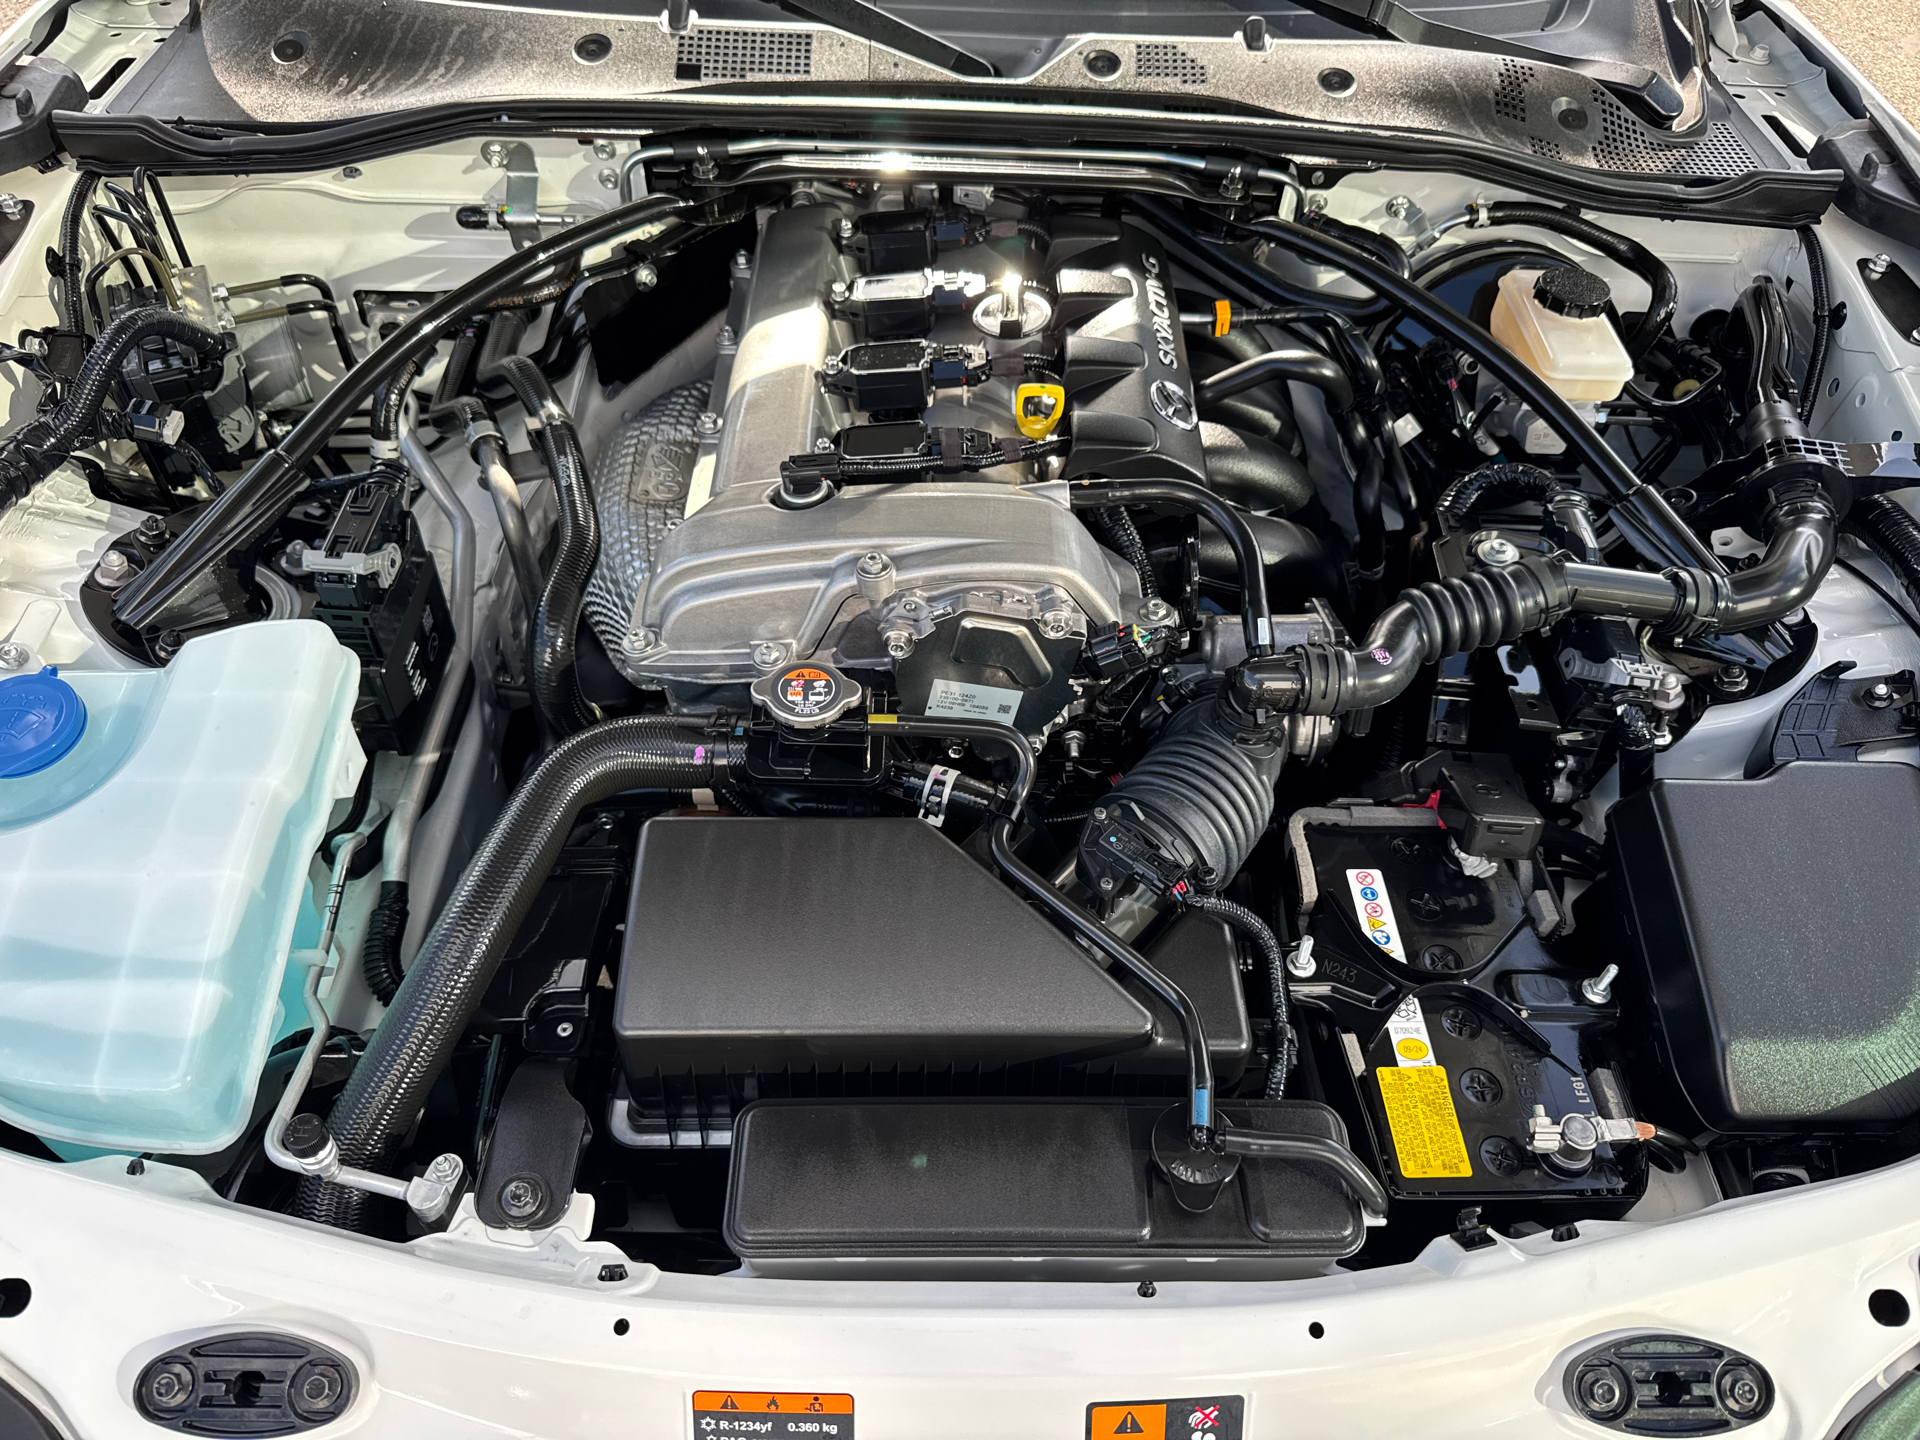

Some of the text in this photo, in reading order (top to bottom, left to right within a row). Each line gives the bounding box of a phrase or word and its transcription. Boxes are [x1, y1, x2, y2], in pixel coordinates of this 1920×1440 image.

[1142, 253, 1178, 370] SKYACTIV-G
[1322, 959, 1357, 983] N243
[1404, 1082, 1420, 1109] POISON
[1437, 1084, 1455, 1117] DANGER
[1570, 1076, 1591, 1103] LFG1
[720, 1421, 838, 1434] R-1234yf 0.360 kg
